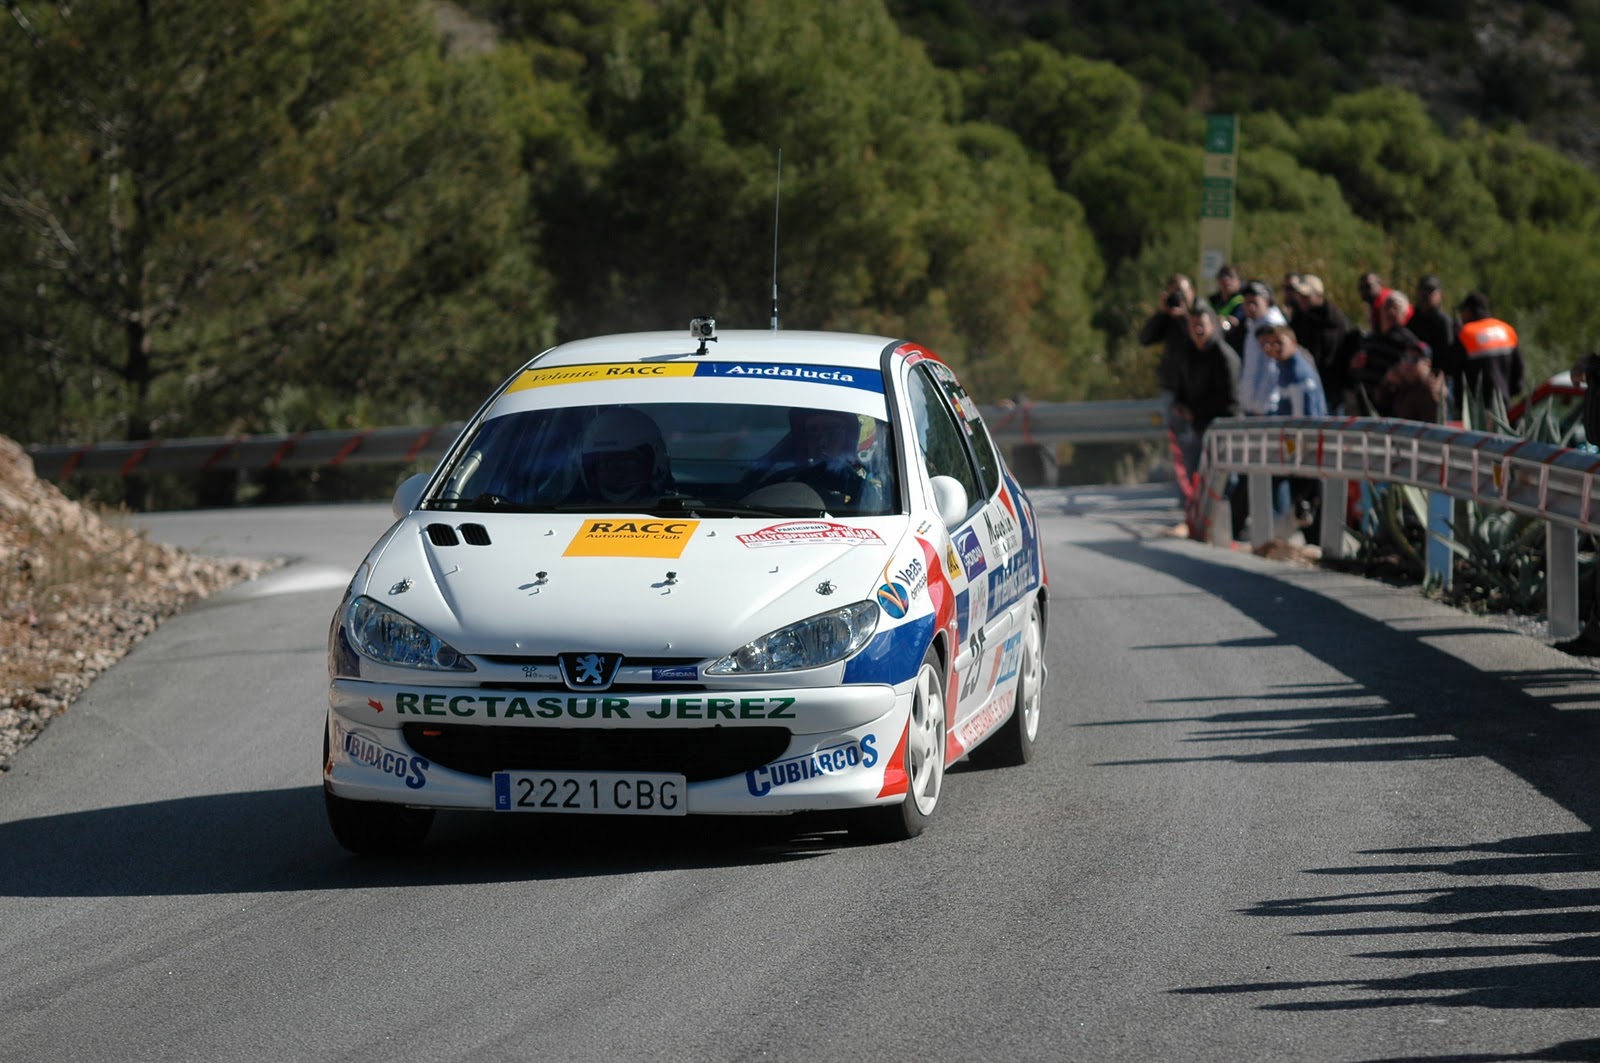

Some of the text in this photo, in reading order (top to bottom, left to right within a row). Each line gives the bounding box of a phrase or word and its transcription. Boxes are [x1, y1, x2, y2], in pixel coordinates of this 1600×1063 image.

[532, 366, 666, 382] Volante RACC
[725, 365, 854, 383] Andalucía
[589, 522, 688, 534] RACC
[740, 531, 824, 543] RALLYESPRINT
[828, 531, 843, 539] DE
[842, 528, 877, 540] MIJAS
[777, 524, 829, 533] PARTICIPANTE
[895, 558, 923, 586] Veas
[395, 691, 796, 720] RECTASUR JEREZ
[334, 719, 430, 790] CUBIARCOS
[745, 733, 878, 797] CUBIARCOS
[499, 795, 507, 805] E
[516, 778, 678, 810] 2221 CBG
